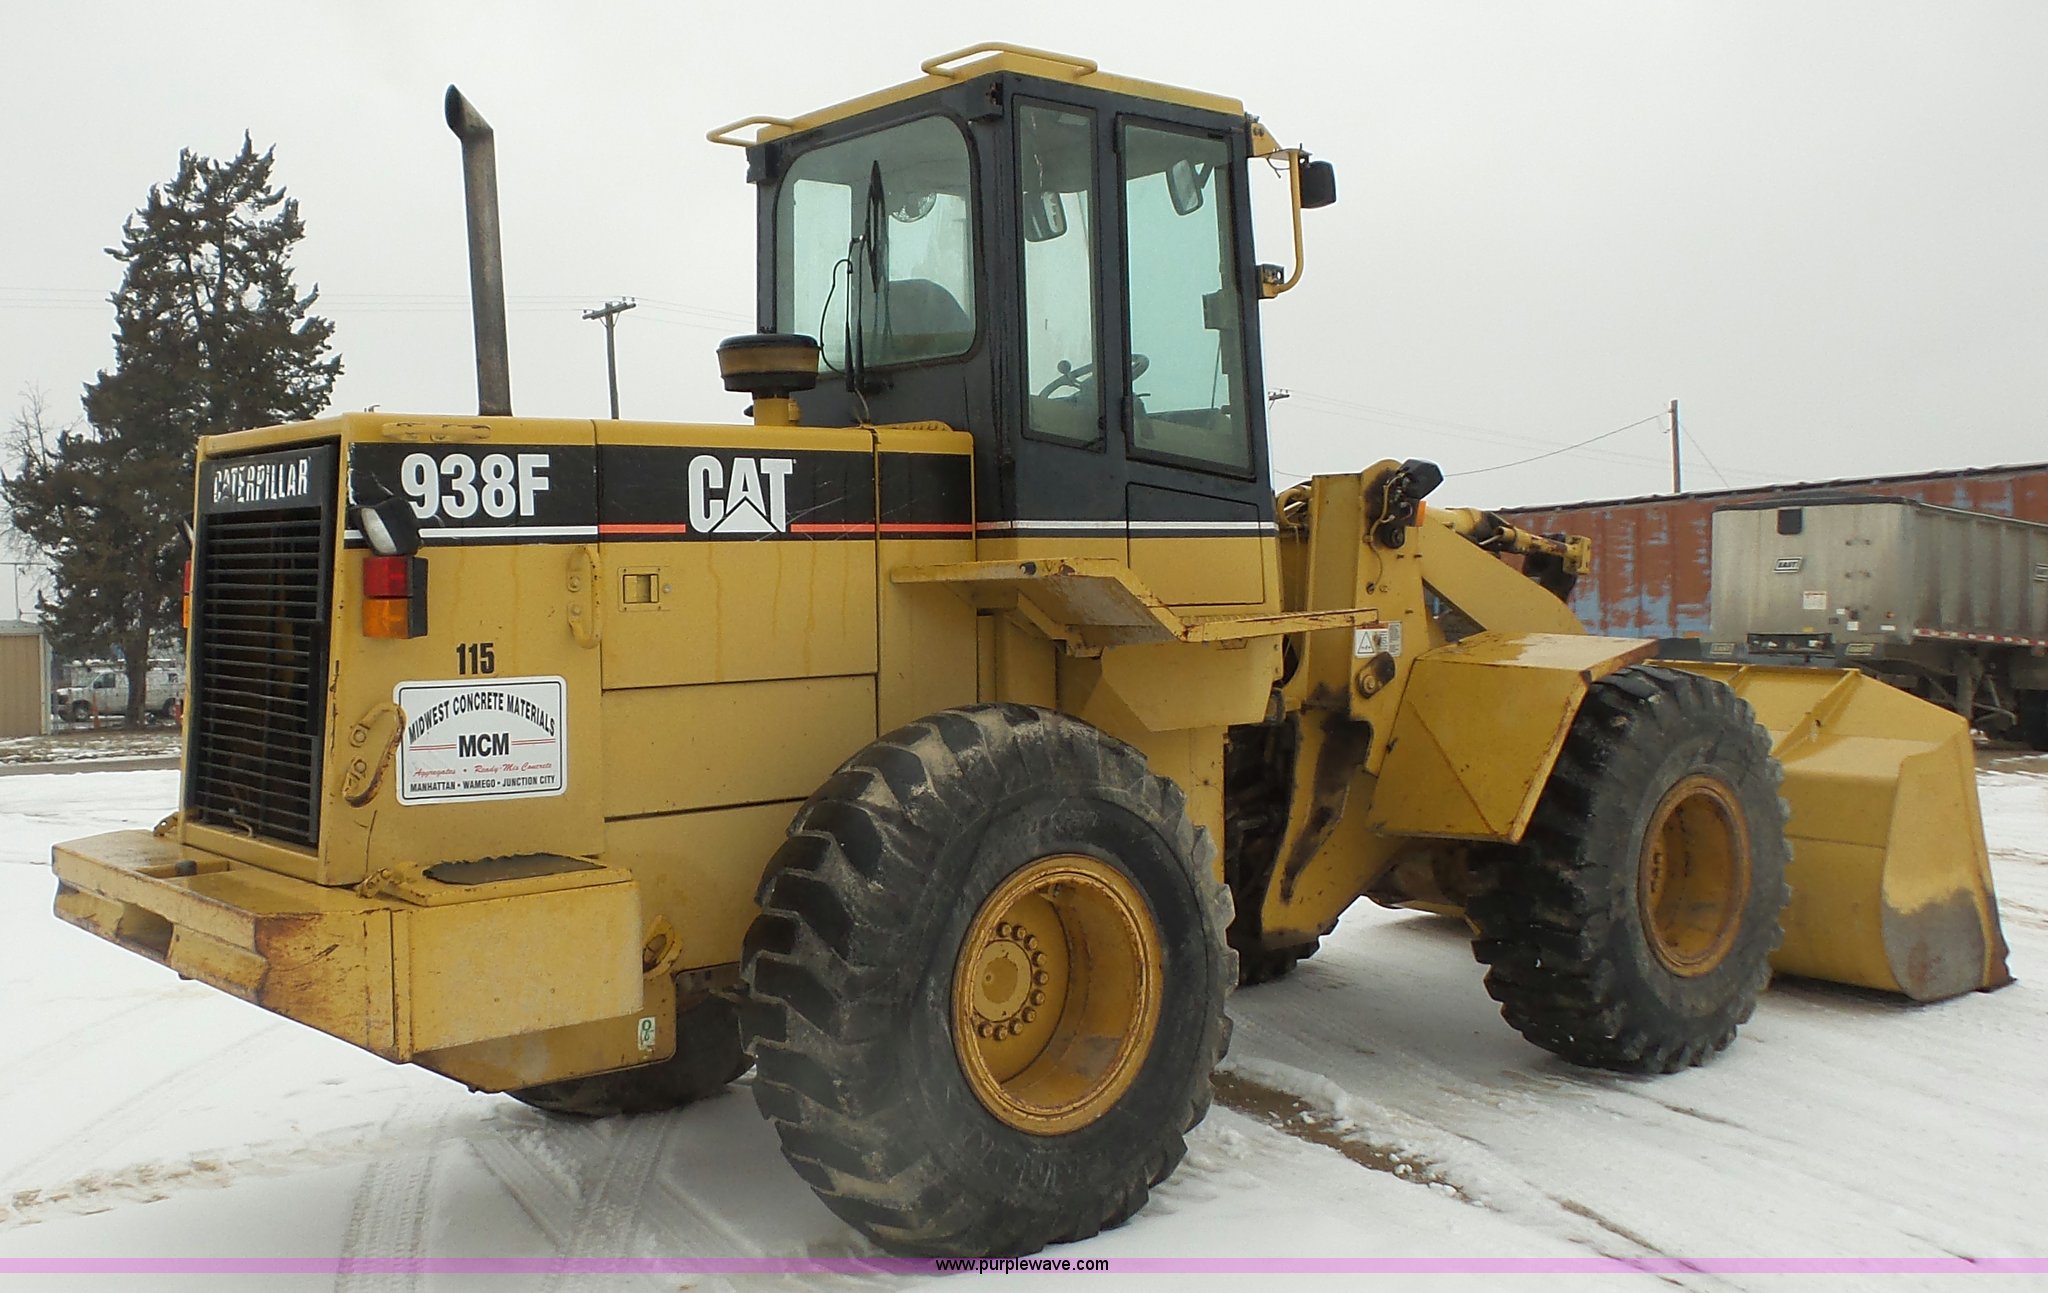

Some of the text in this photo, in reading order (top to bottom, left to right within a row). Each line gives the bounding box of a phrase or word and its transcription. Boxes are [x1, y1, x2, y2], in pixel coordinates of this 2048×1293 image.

[401, 453, 550, 519] 938F
[688, 455, 793, 533] CAT
[456, 643, 495, 675] 115
[408, 691, 555, 745] MIDWEST CONCRETE MATERIALS
[458, 733, 510, 757] MCM
[410, 775, 556, 793] MANHATTAN WAMEGO JUNCTION CITY
[412, 768, 456, 778] Aggregates
